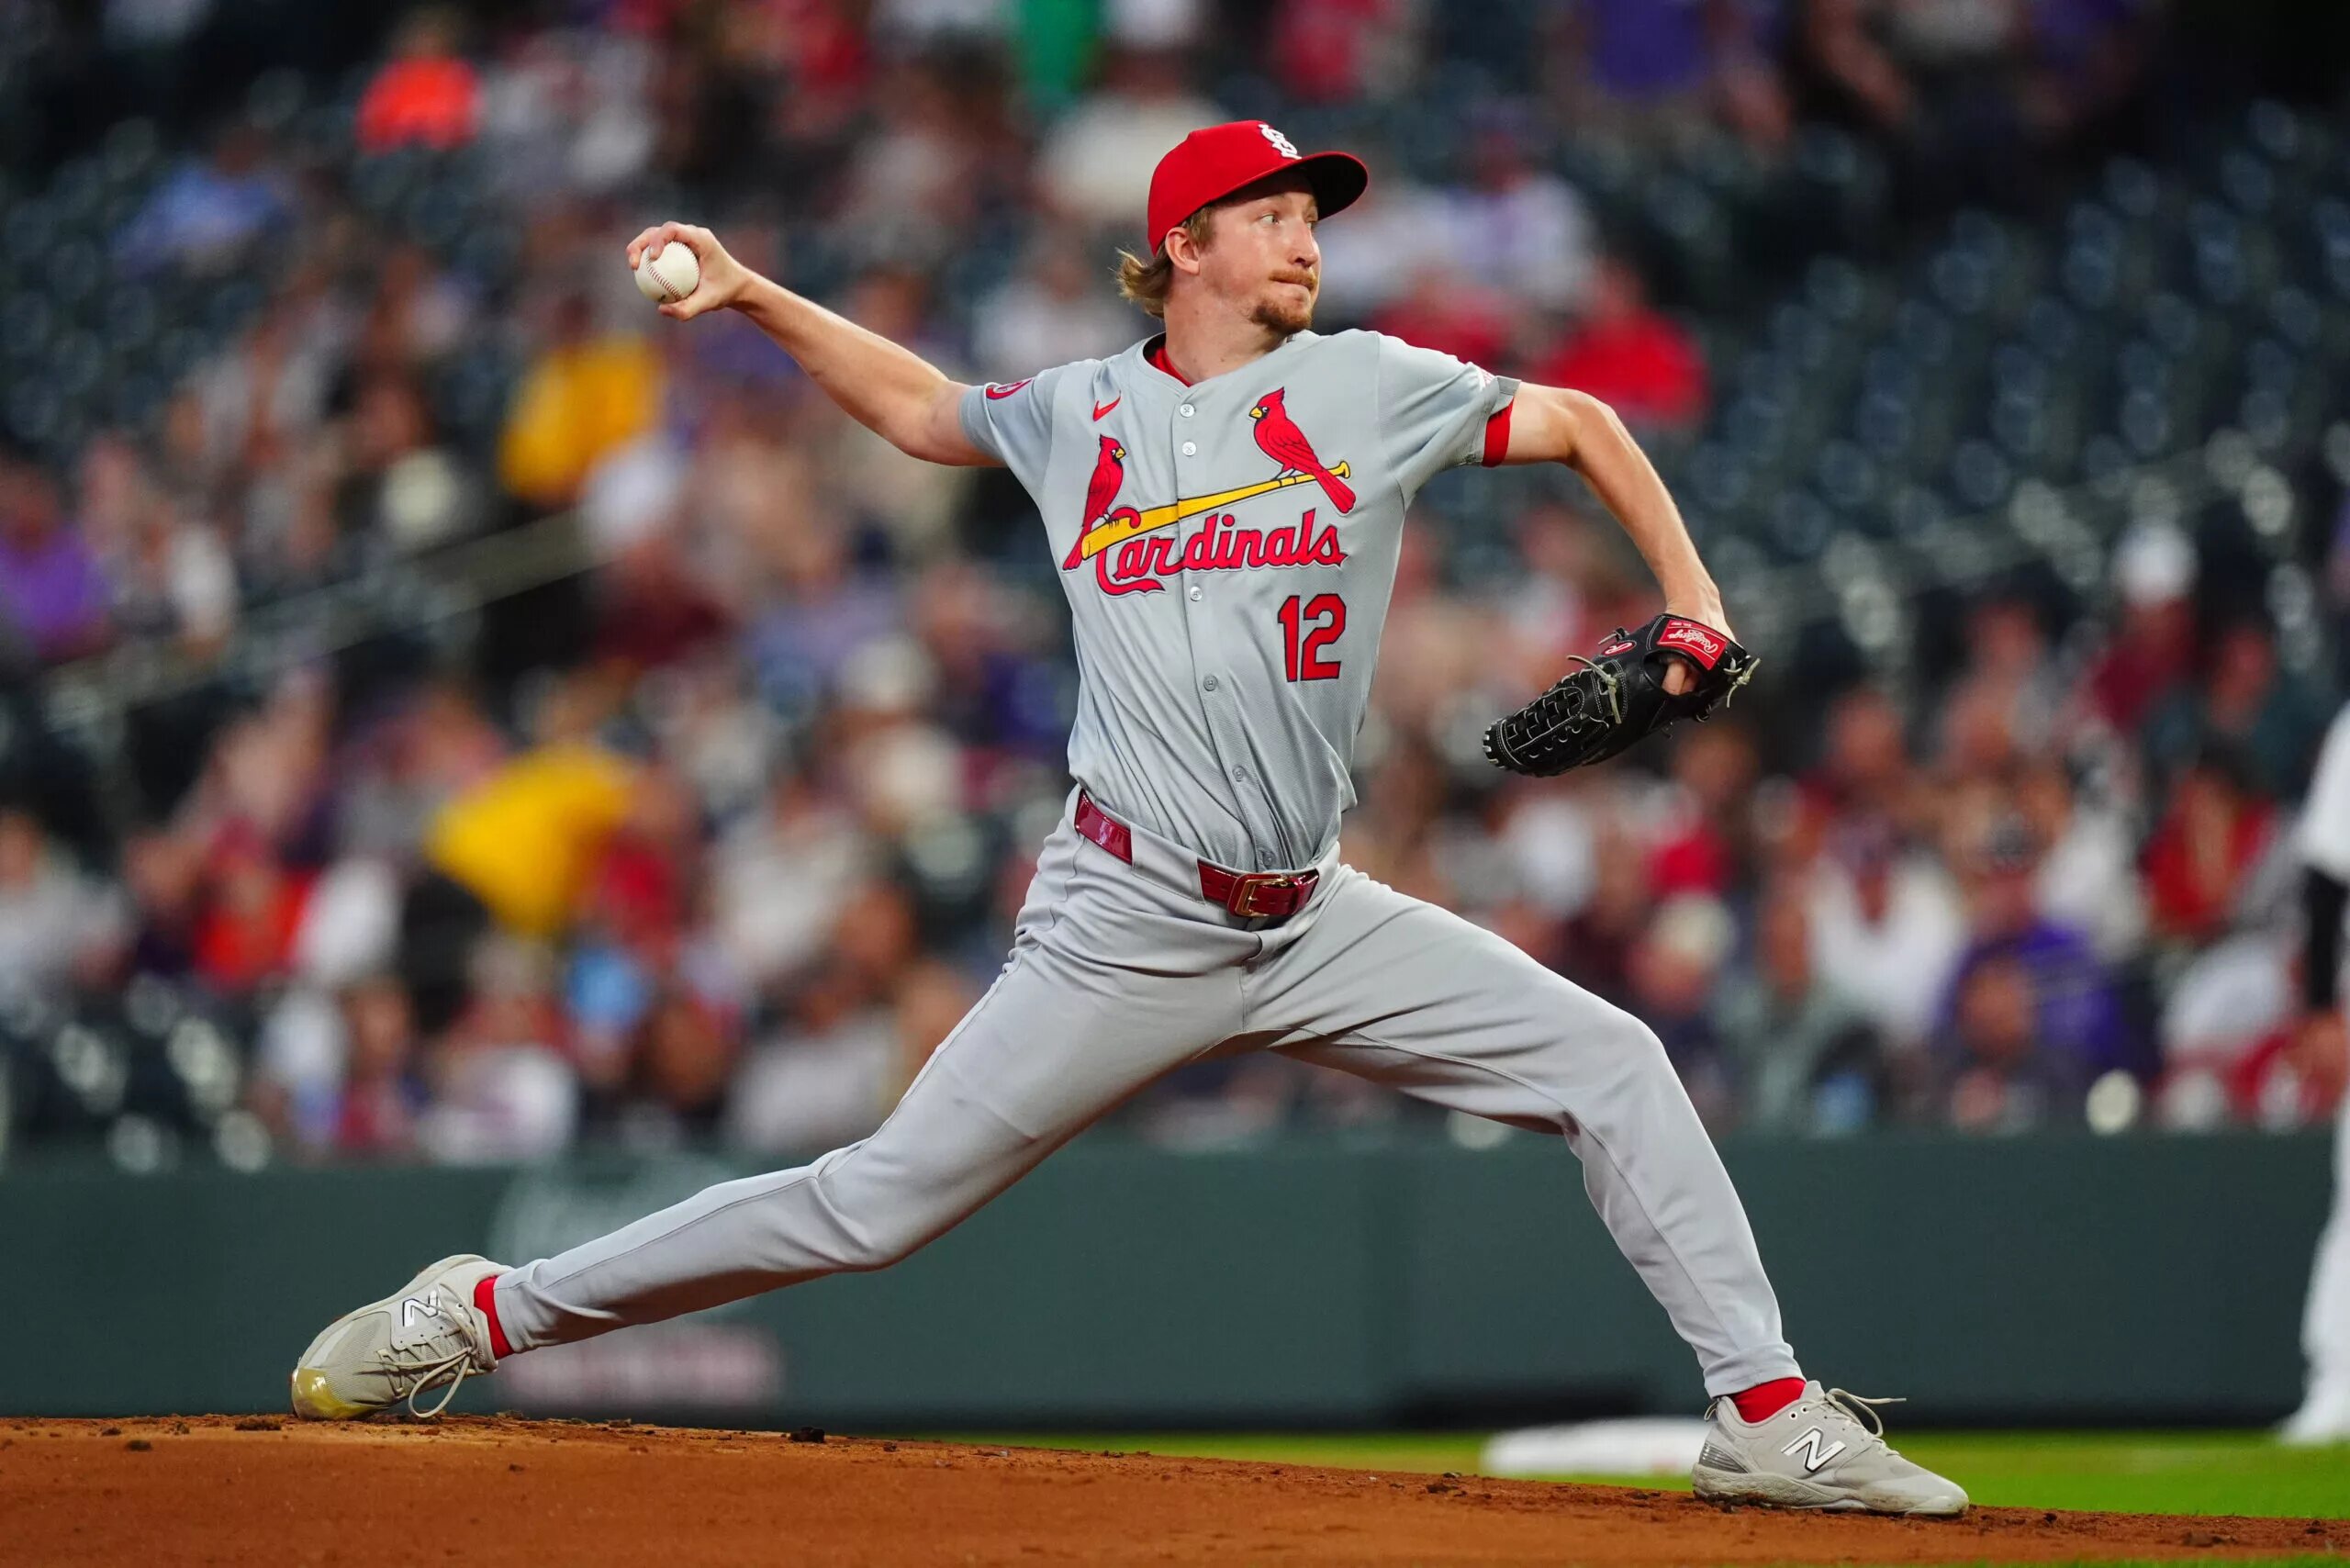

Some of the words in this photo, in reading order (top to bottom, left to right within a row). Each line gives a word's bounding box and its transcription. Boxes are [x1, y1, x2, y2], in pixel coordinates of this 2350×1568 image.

[1095, 507, 1348, 596] Cardinals
[1278, 593, 1347, 682] 12
[1667, 629, 1718, 654] Rawlings
[1781, 1425, 1847, 1473] N
